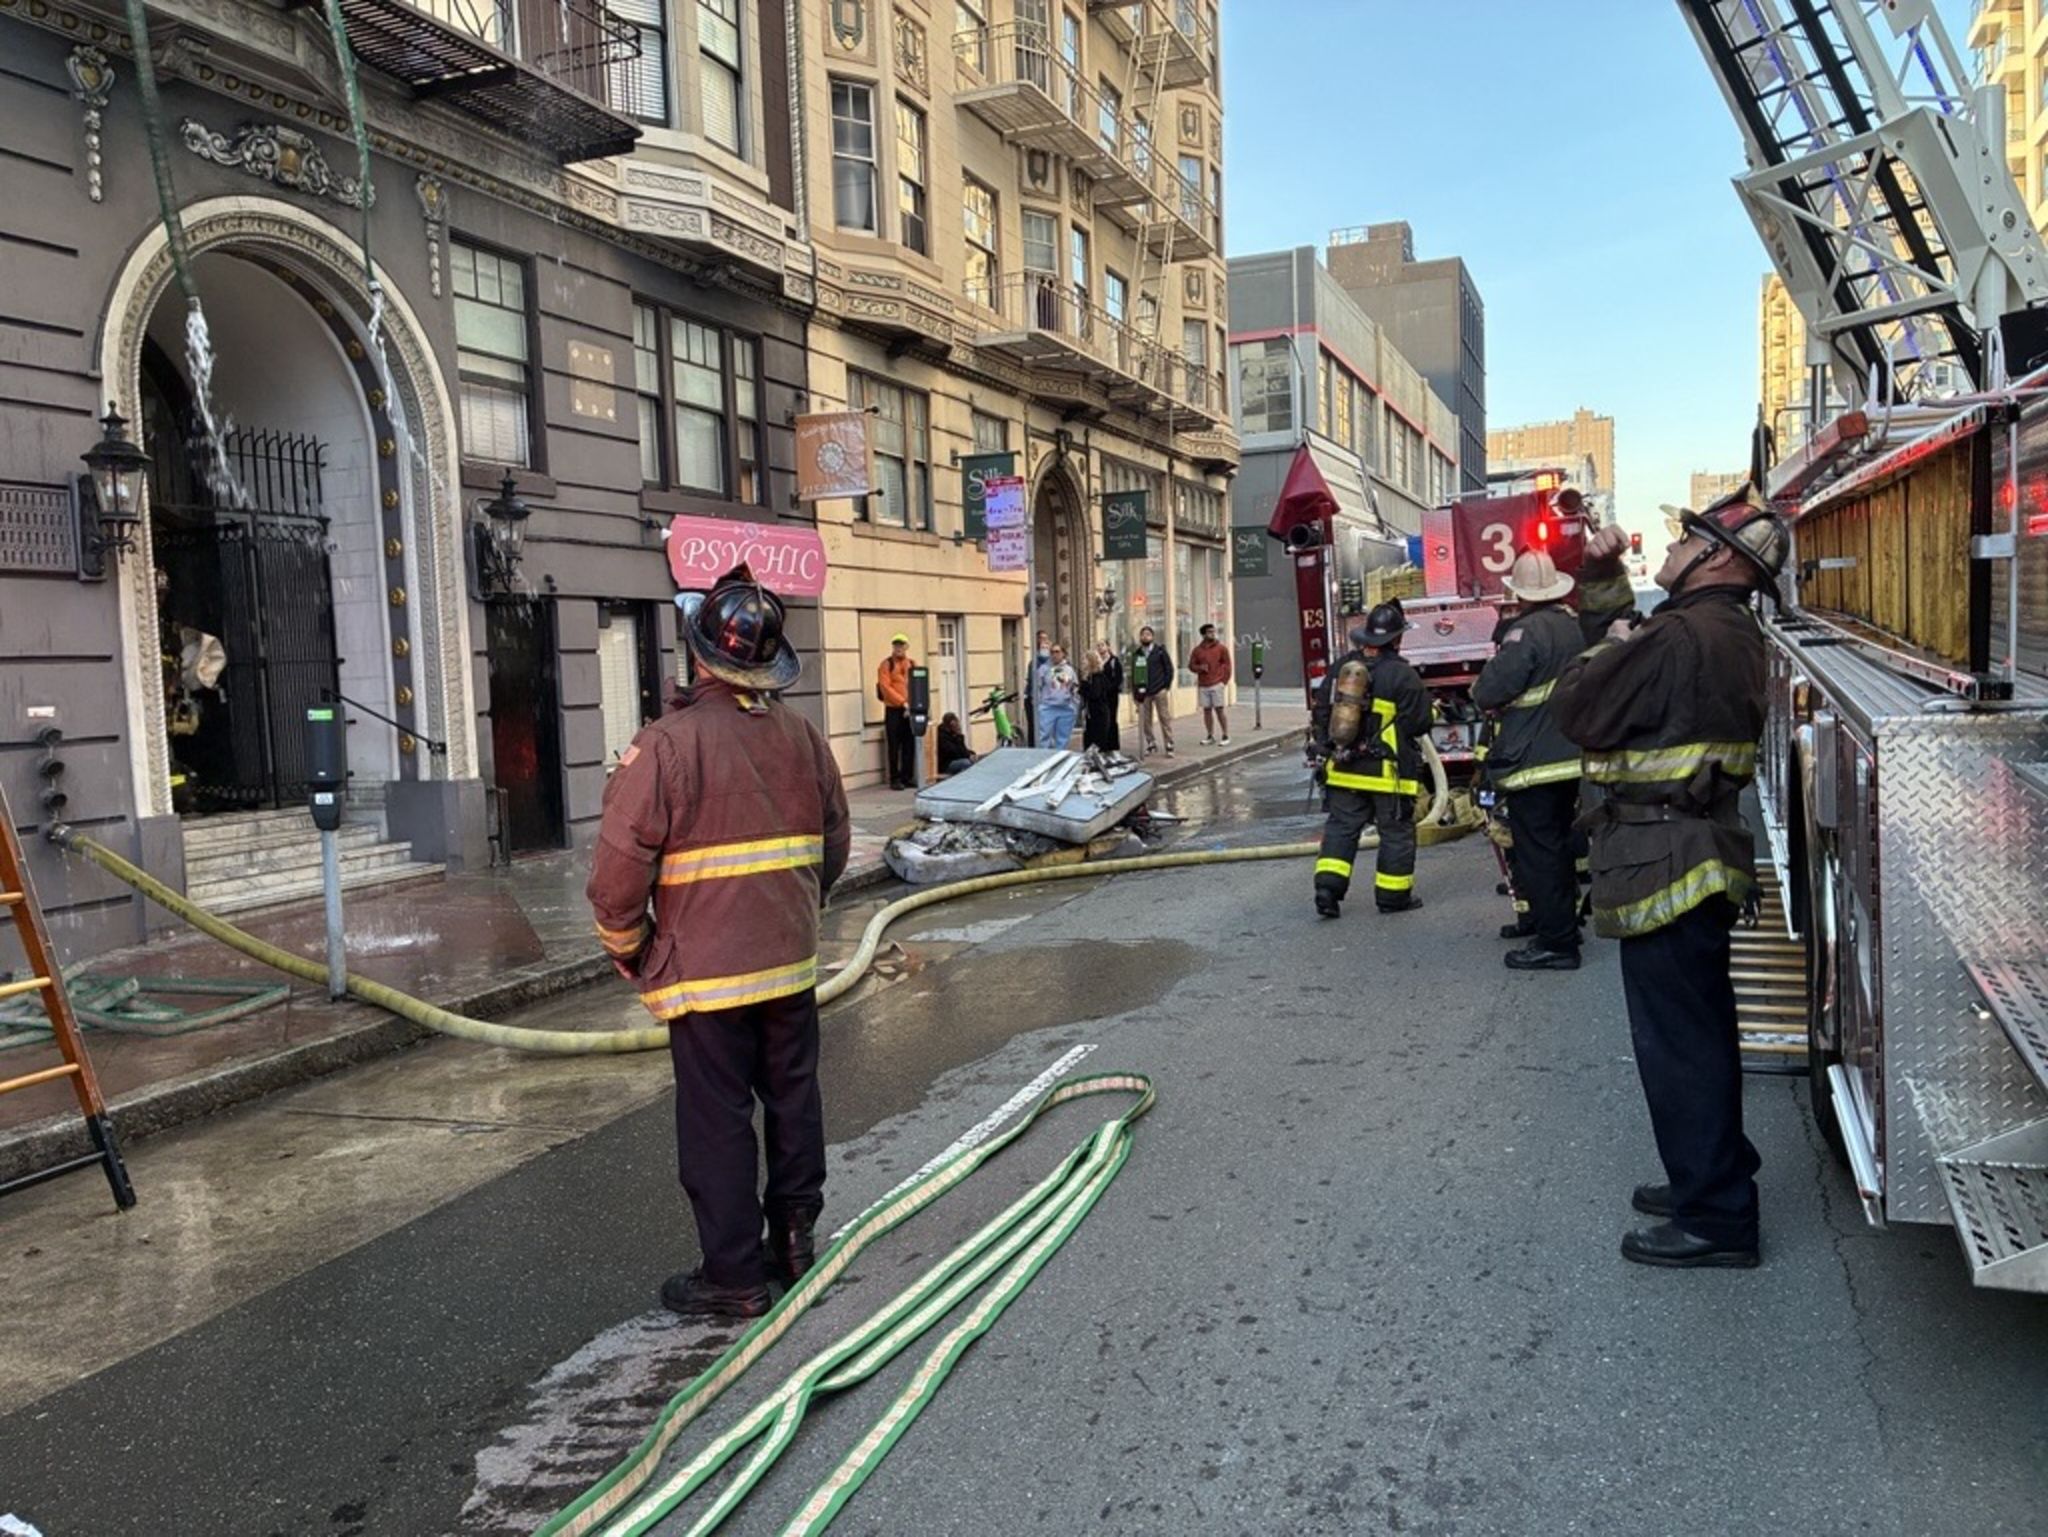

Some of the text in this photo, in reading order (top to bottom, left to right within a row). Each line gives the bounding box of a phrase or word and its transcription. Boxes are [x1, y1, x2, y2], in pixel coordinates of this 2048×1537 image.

[1106, 502, 1143, 529] Silk
[680, 537, 819, 580] PSYCHIC
[1481, 522, 1516, 573] 3
